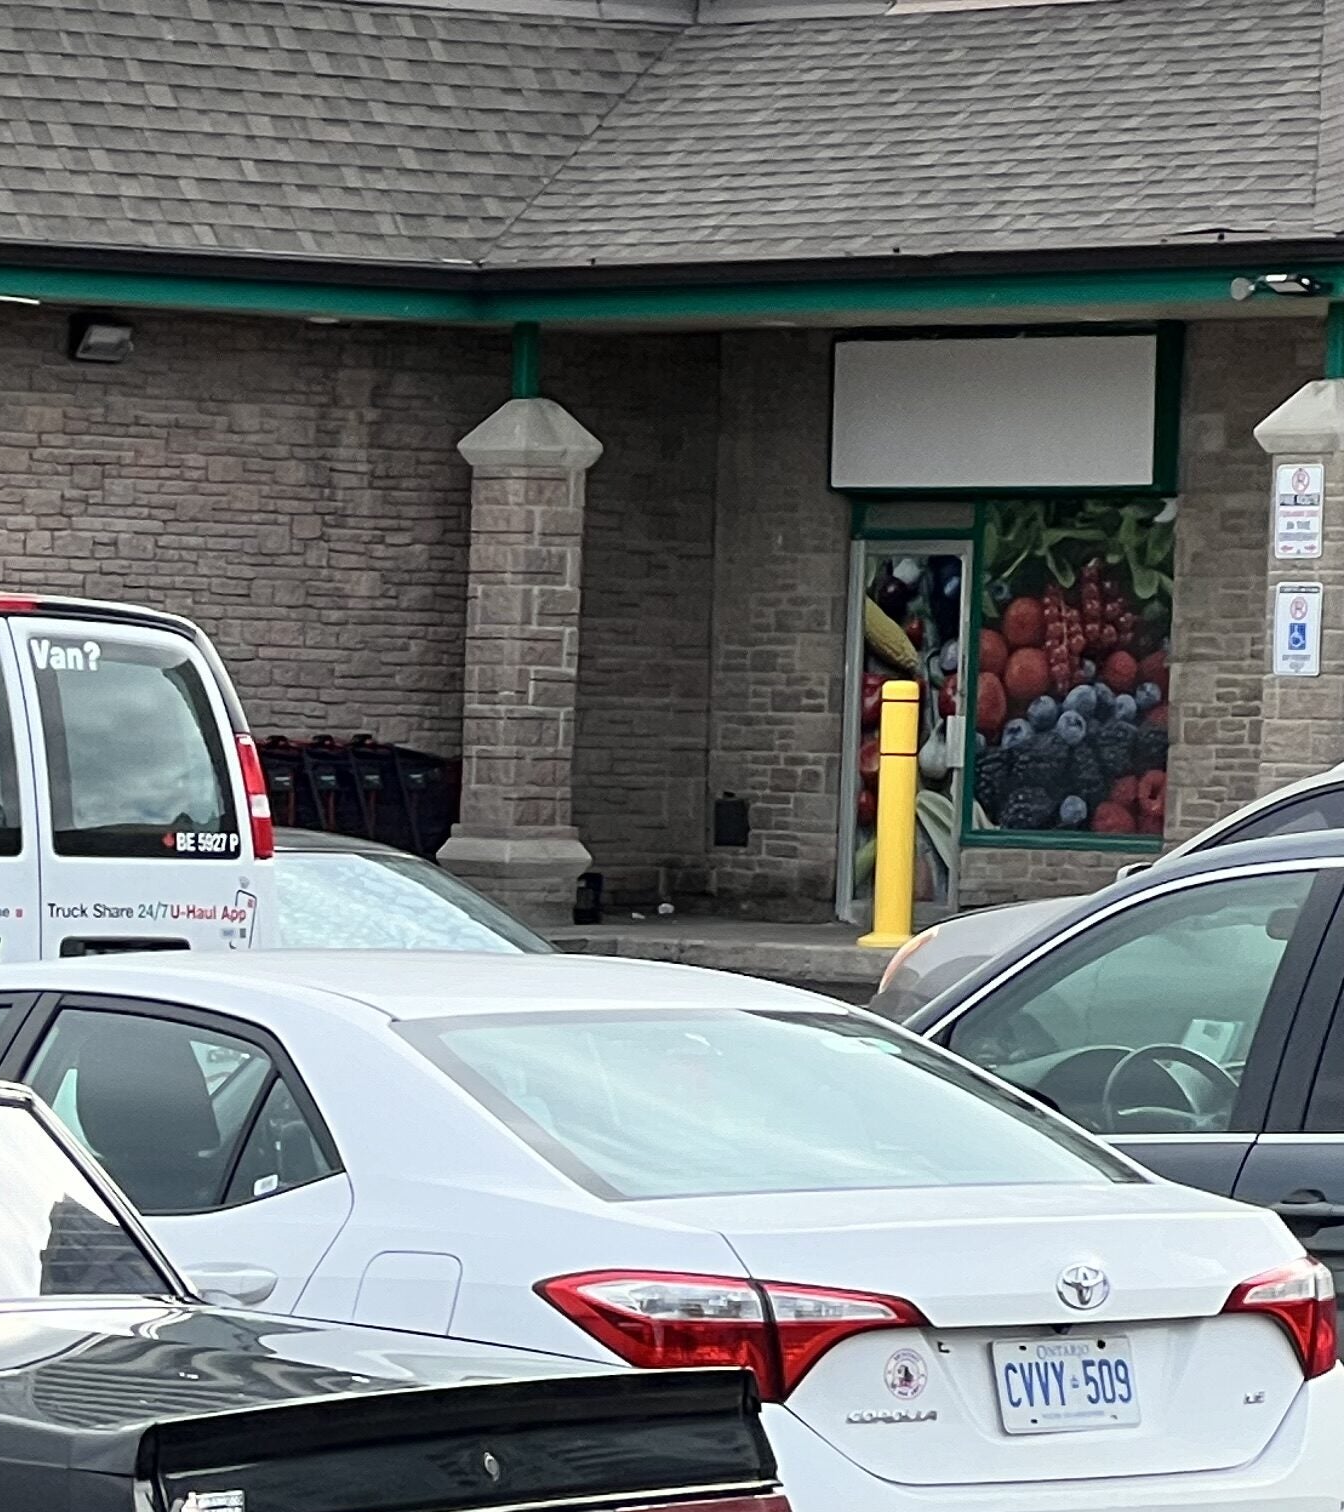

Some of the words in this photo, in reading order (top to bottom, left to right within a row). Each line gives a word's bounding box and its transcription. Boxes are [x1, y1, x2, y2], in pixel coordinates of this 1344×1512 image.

[29, 638, 102, 672] Van?
[176, 832, 197, 852] BE
[230, 833, 239, 852] P
[47, 902, 88, 919] Truck
[92, 902, 134, 919] Share
[138, 901, 168, 921] 24/7
[169, 904, 217, 921] U-Haul
[220, 905, 247, 924] App
[1004, 1360, 1066, 1408] CVVY
